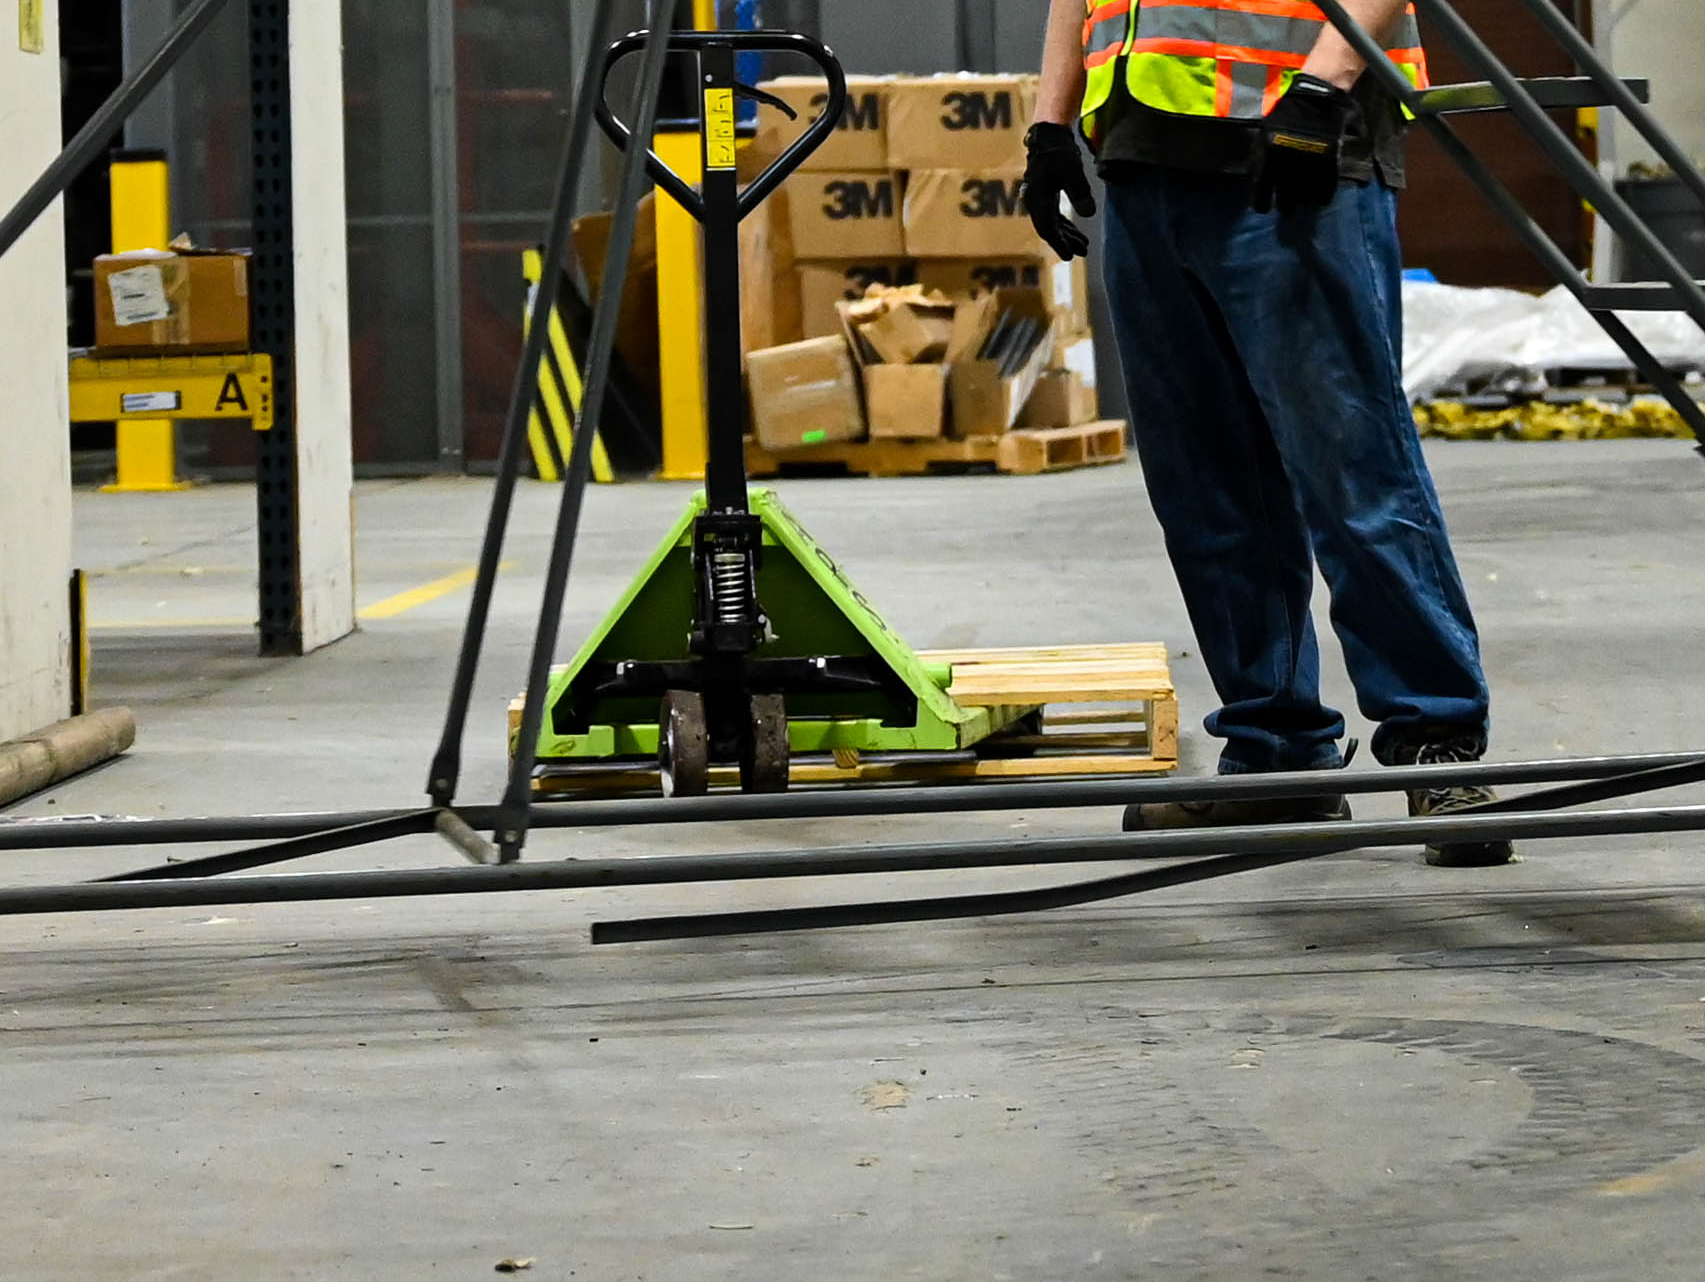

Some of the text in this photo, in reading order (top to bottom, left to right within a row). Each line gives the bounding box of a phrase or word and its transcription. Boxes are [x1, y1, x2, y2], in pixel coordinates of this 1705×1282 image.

[940, 91, 1012, 130] 3M
[822, 180, 894, 219] 3M
[959, 179, 1030, 217] 3M
[215, 373, 248, 411] A
